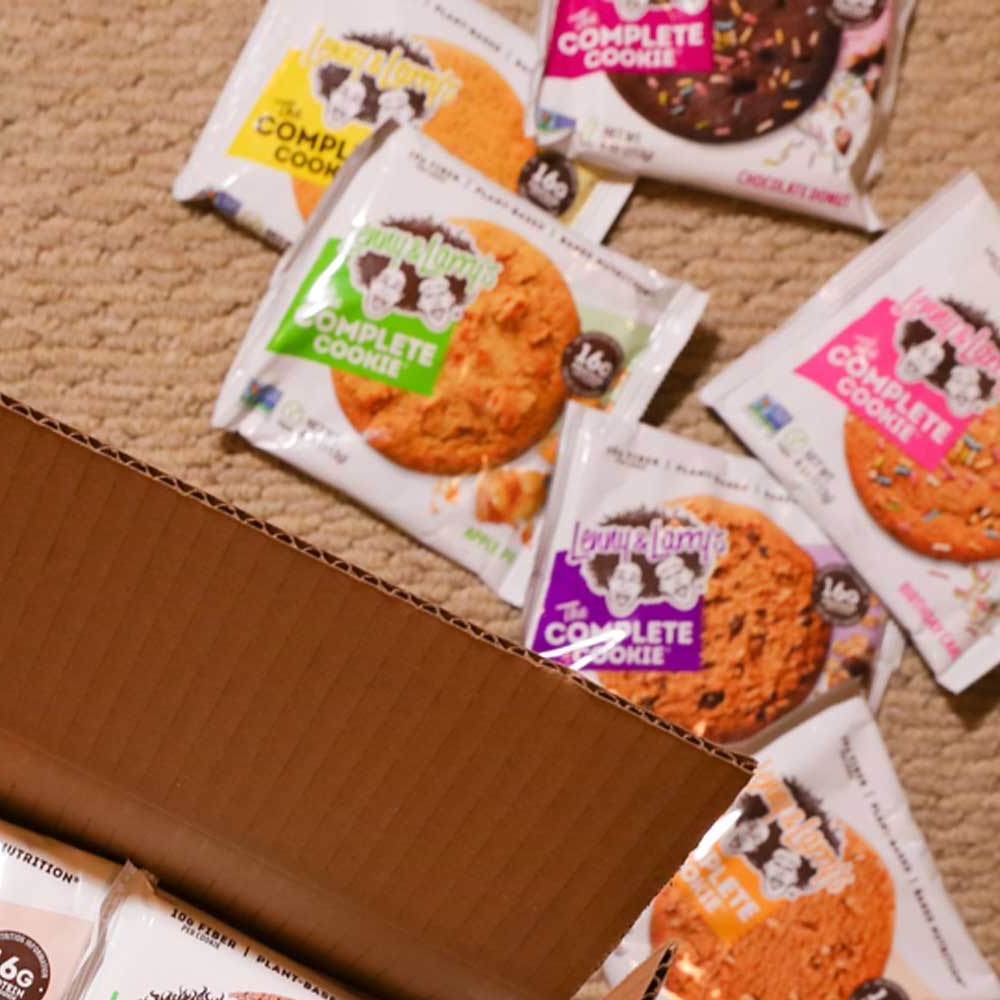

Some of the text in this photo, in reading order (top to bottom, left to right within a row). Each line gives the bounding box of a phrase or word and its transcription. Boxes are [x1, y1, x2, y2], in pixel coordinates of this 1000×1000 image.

[557, 21, 705, 55] COMPLETE
[583, 45, 677, 69] COOKIE
[255, 114, 351, 160] COMPL
[274, 146, 339, 178] COOK
[313, 335, 402, 379] COOKIE
[827, 344, 955, 444] COMPLETE
[837, 378, 916, 445] COOKIE
[555, 601, 590, 622] The
[544, 620, 694, 646] COMPLETE
[571, 645, 666, 667] COOKIE
[680, 863, 722, 915] OKIE
[699, 852, 760, 924] PLETE
[197, 922, 238, 949] FIBER
